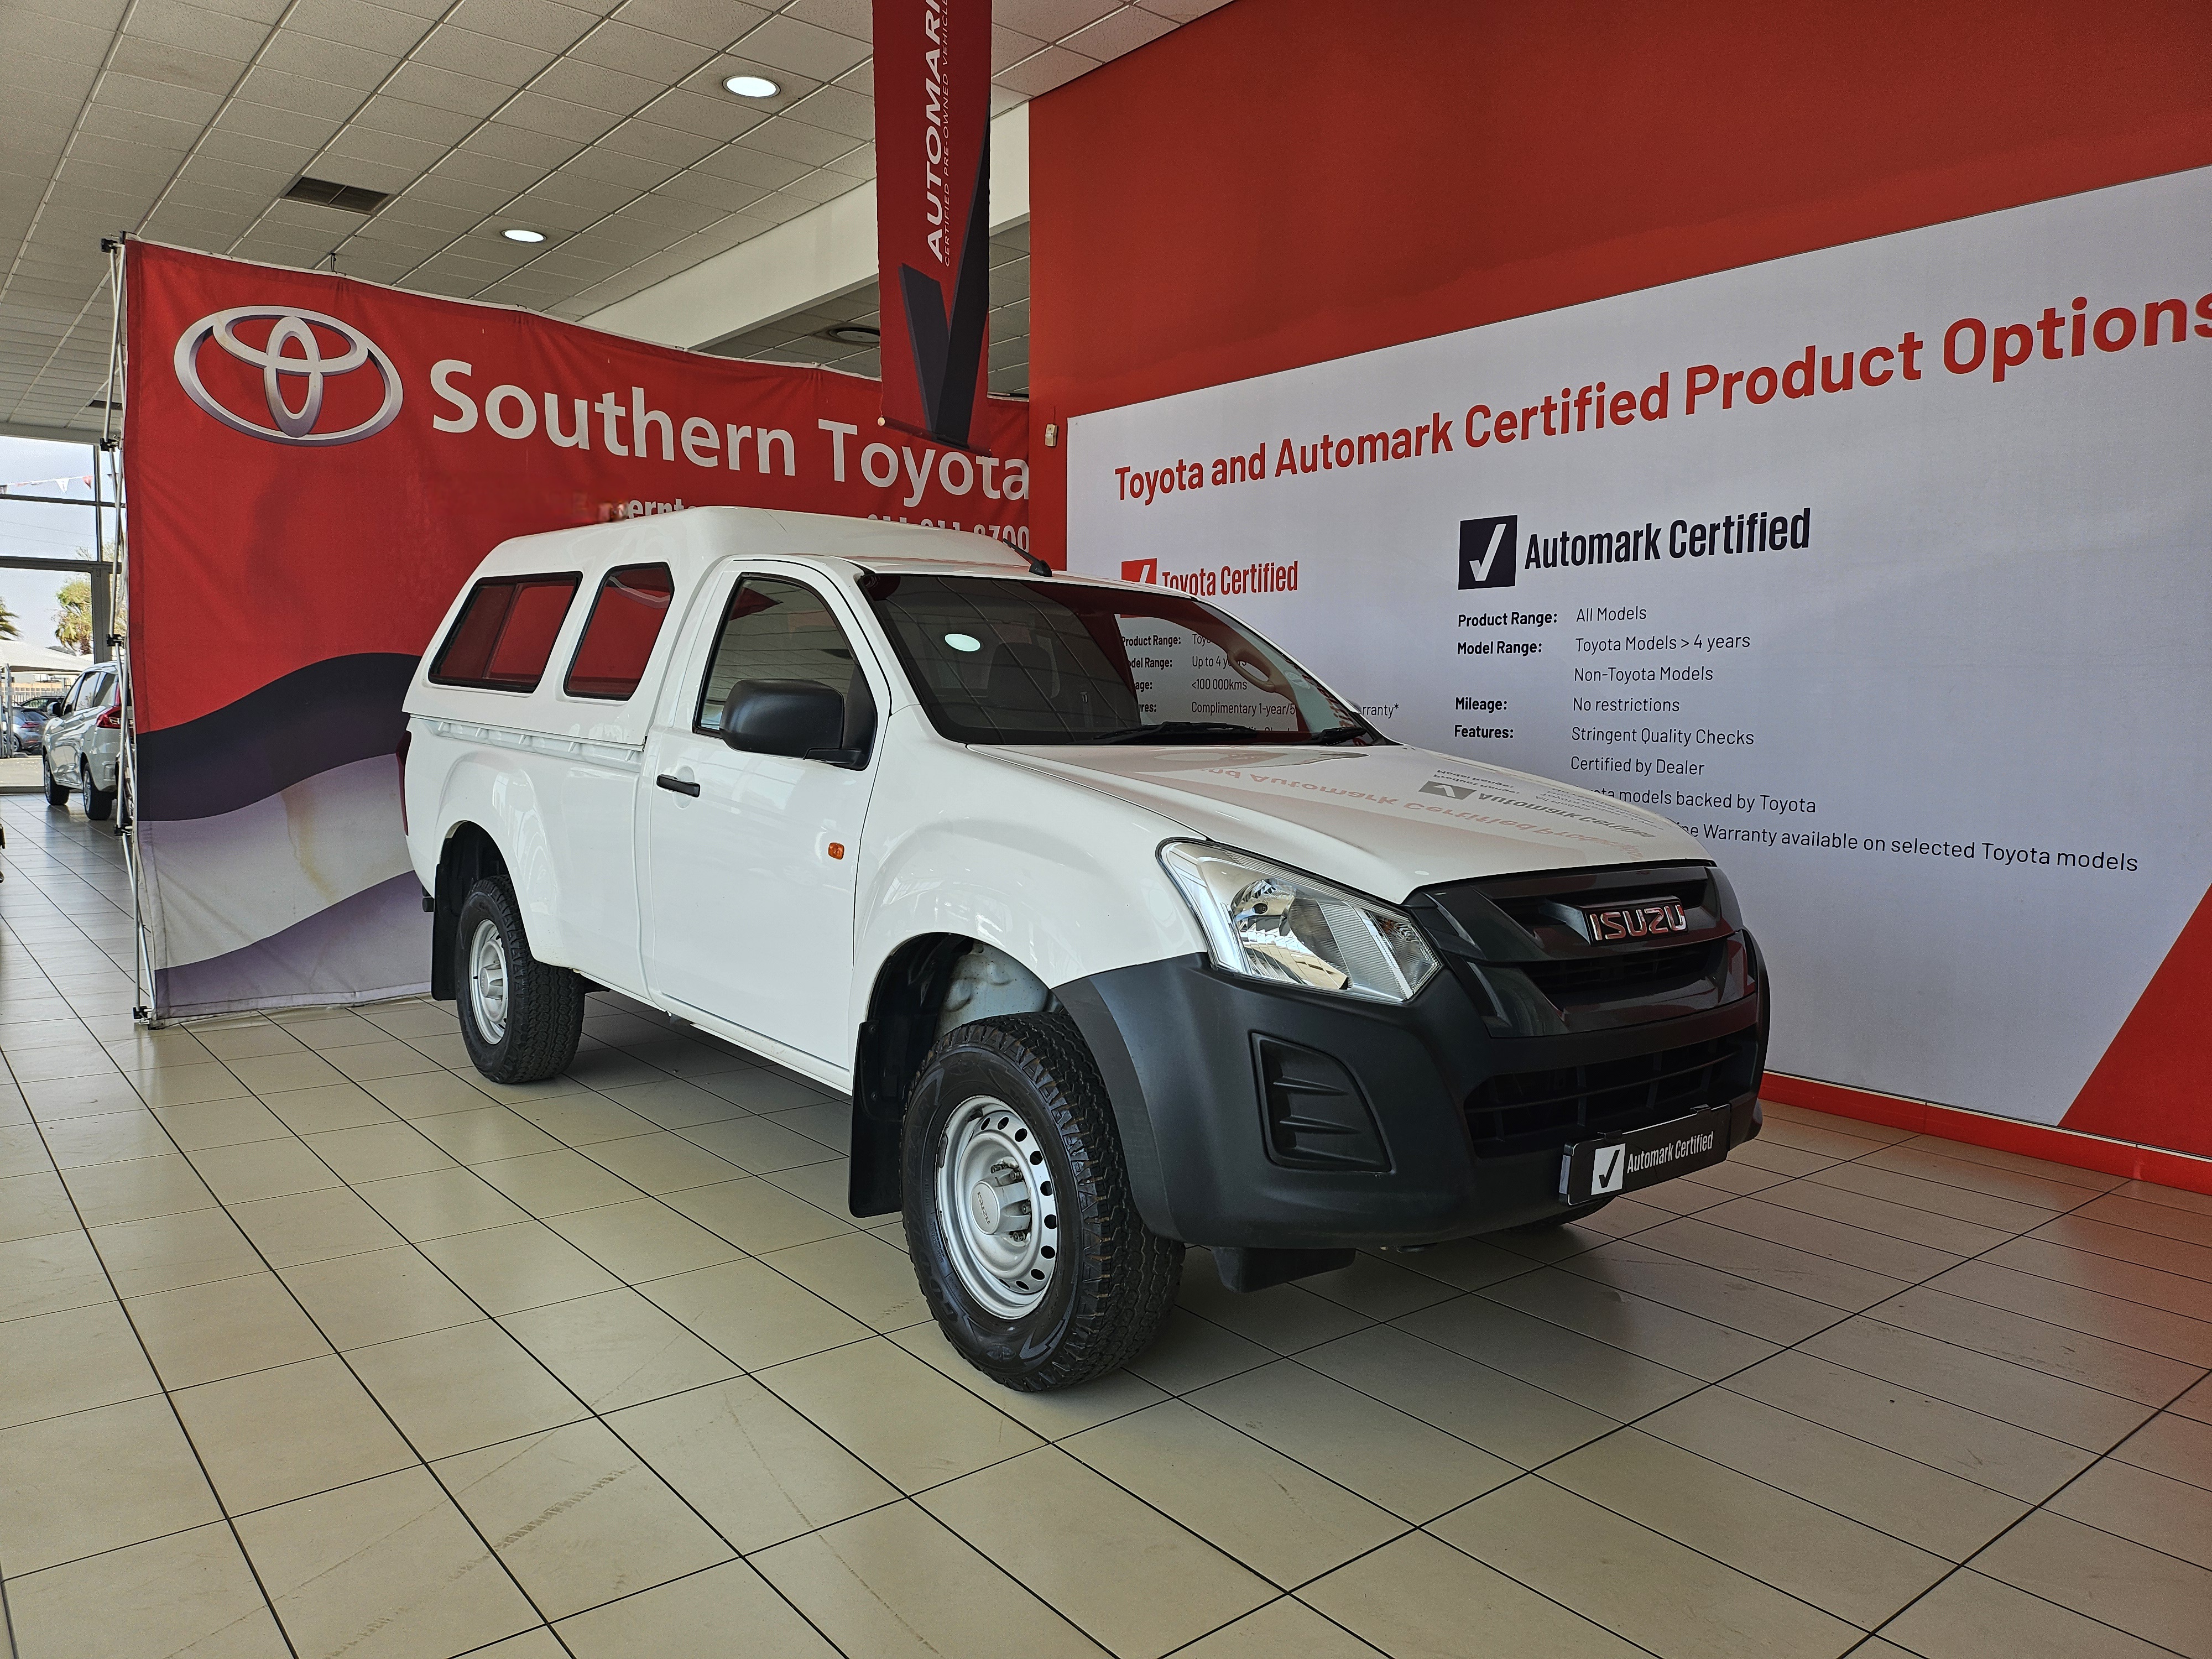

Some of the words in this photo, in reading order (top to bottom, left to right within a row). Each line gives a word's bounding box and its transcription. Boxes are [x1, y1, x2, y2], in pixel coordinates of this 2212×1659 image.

[1115, 460, 1203, 505] Toyota
[1212, 443, 1265, 486] and
[1276, 413, 1452, 476] Automark
[1466, 372, 1668, 447] Certified
[1686, 332, 1922, 414] Product
[430, 359, 795, 476] Southern
[818, 419, 1029, 507] Toyota
[1525, 523, 1661, 569] Automark
[1670, 508, 1810, 558] Certified
[1162, 568, 1216, 596] Toyota
[1221, 561, 1298, 595] Certified
[1458, 613, 1507, 627] Product
[1511, 612, 1557, 627] Range:
[1577, 608, 1592, 622] All
[1598, 606, 1646, 621] Models
[1121, 636, 1151, 646] Product
[1153, 635, 1181, 647] Range:
[1458, 641, 1493, 654] Model
[1497, 641, 1542, 656] Range:
[1575, 638, 1620, 655] Toyota
[1626, 635, 1676, 650] Models
[1694, 634, 1702, 648] 4
[1707, 637, 1750, 652] years
[1145, 658, 1172, 670] Range:
[1193, 656, 1203, 669] Up
[1205, 657, 1213, 666] to
[1216, 656, 1220, 666] 4
[1192, 679, 1210, 689] <100
[1213, 679, 1247, 690] 000kms
[1575, 667, 1655, 685] Non-Toyota
[1661, 666, 1713, 680] Models
[1192, 702, 1256, 717] Complimentary
[1455, 697, 1507, 713] Mileage:
[1574, 697, 1590, 711] No
[1596, 698, 1679, 711] restrictions
[1455, 725, 1513, 738] Features:
[1572, 727, 1637, 744] Stringent
[1642, 728, 1691, 747] Quality
[1697, 729, 1754, 744] Checks
[1571, 757, 1631, 771] Certified
[1636, 759, 1652, 776] by
[1657, 759, 1704, 775] Dealer
[1619, 789, 1672, 805] models
[1677, 791, 1731, 808] backed
[1738, 794, 1755, 812] by
[1760, 795, 1815, 815] Toyota
[1704, 824, 1777, 846] Warranty
[1782, 831, 1857, 849] available
[1864, 839, 1885, 851] on
[1891, 838, 1974, 858] selected
[1982, 843, 2049, 865] Toyota
[2058, 852, 2137, 871] models
[1589, 905, 1686, 941] ISUZU
[1627, 1143, 1673, 1173] Automark
[1675, 1131, 1713, 1159] Certified
[977, 1191, 990, 1224] ISUZU
